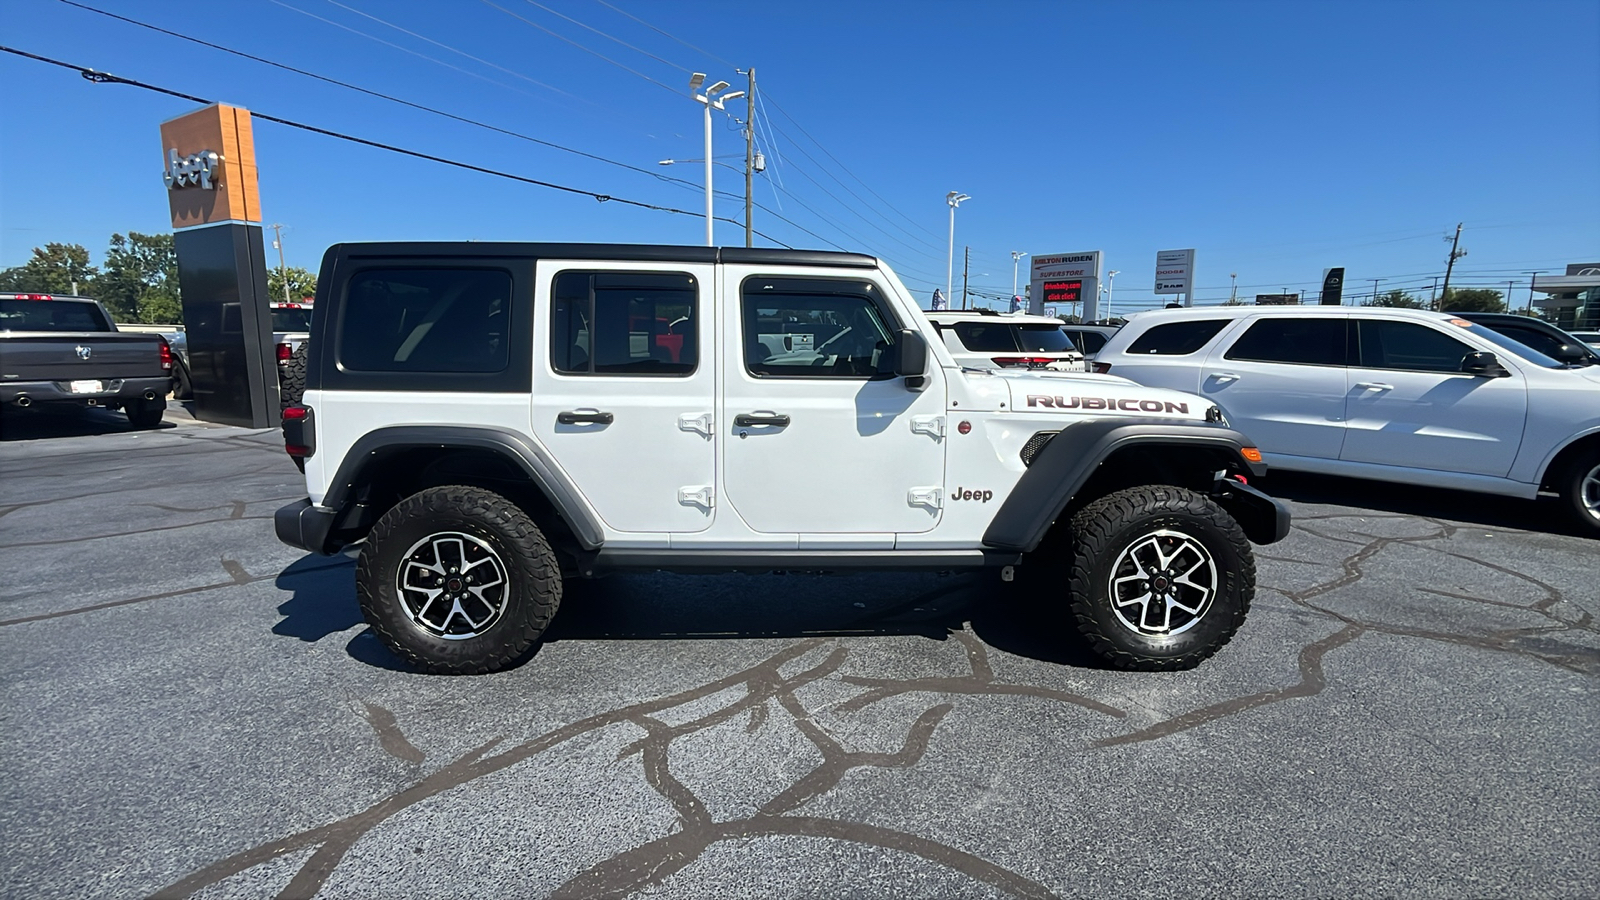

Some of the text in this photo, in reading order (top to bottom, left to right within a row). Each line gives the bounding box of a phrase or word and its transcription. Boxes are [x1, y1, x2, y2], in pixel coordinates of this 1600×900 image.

[162, 148, 218, 190] Jeep
[1062, 255, 1093, 263] RUBEN
[1039, 269, 1085, 278] SUPERSTORE
[1026, 394, 1190, 414] RUBICON
[951, 486, 993, 504] Jeep
